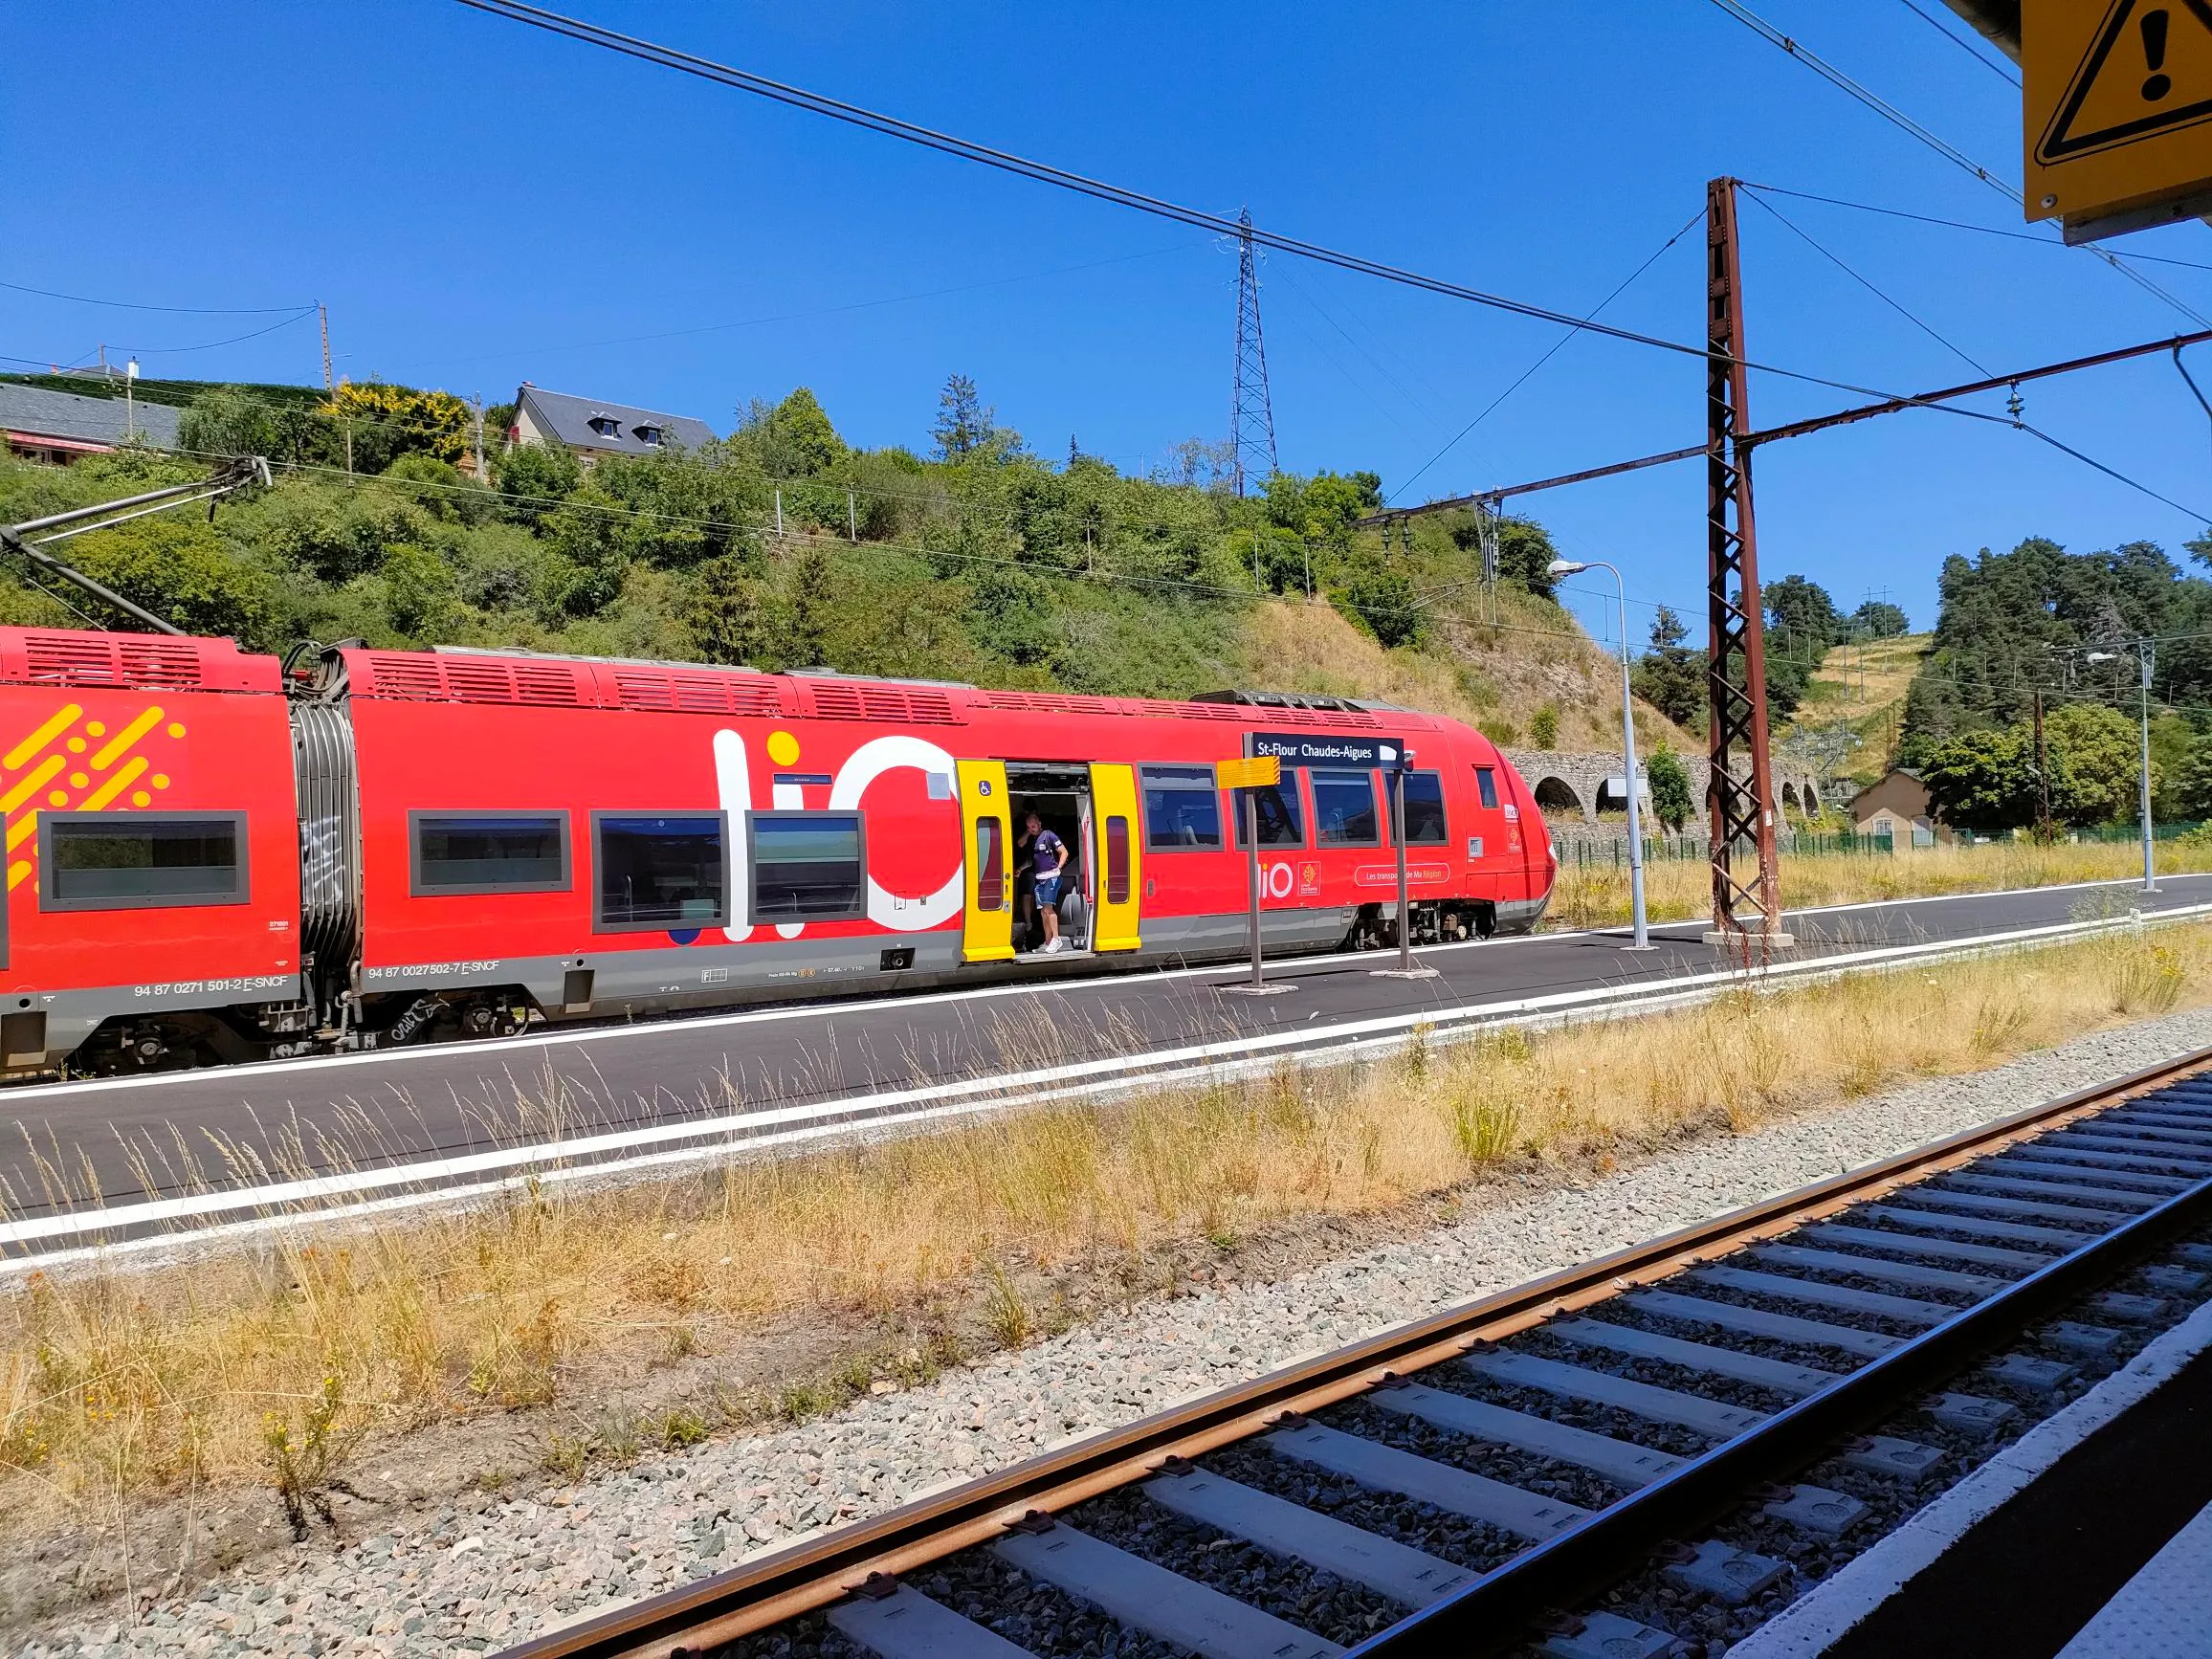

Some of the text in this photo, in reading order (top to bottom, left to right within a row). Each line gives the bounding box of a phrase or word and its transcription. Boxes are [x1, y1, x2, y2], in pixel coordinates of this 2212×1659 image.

[1257, 741, 1373, 762] St-Flour Chaudes-Aigues
[1366, 872, 1377, 880] Les
[1377, 871, 1399, 881] transpo
[1413, 870, 1423, 878] Ma
[1423, 870, 1442, 879] Région
[368, 968, 383, 979] 94
[385, 966, 400, 978] 87
[461, 960, 499, 975] F-SNCF
[134, 975, 289, 997] 94 87 0271 501-2 F-SNCF
